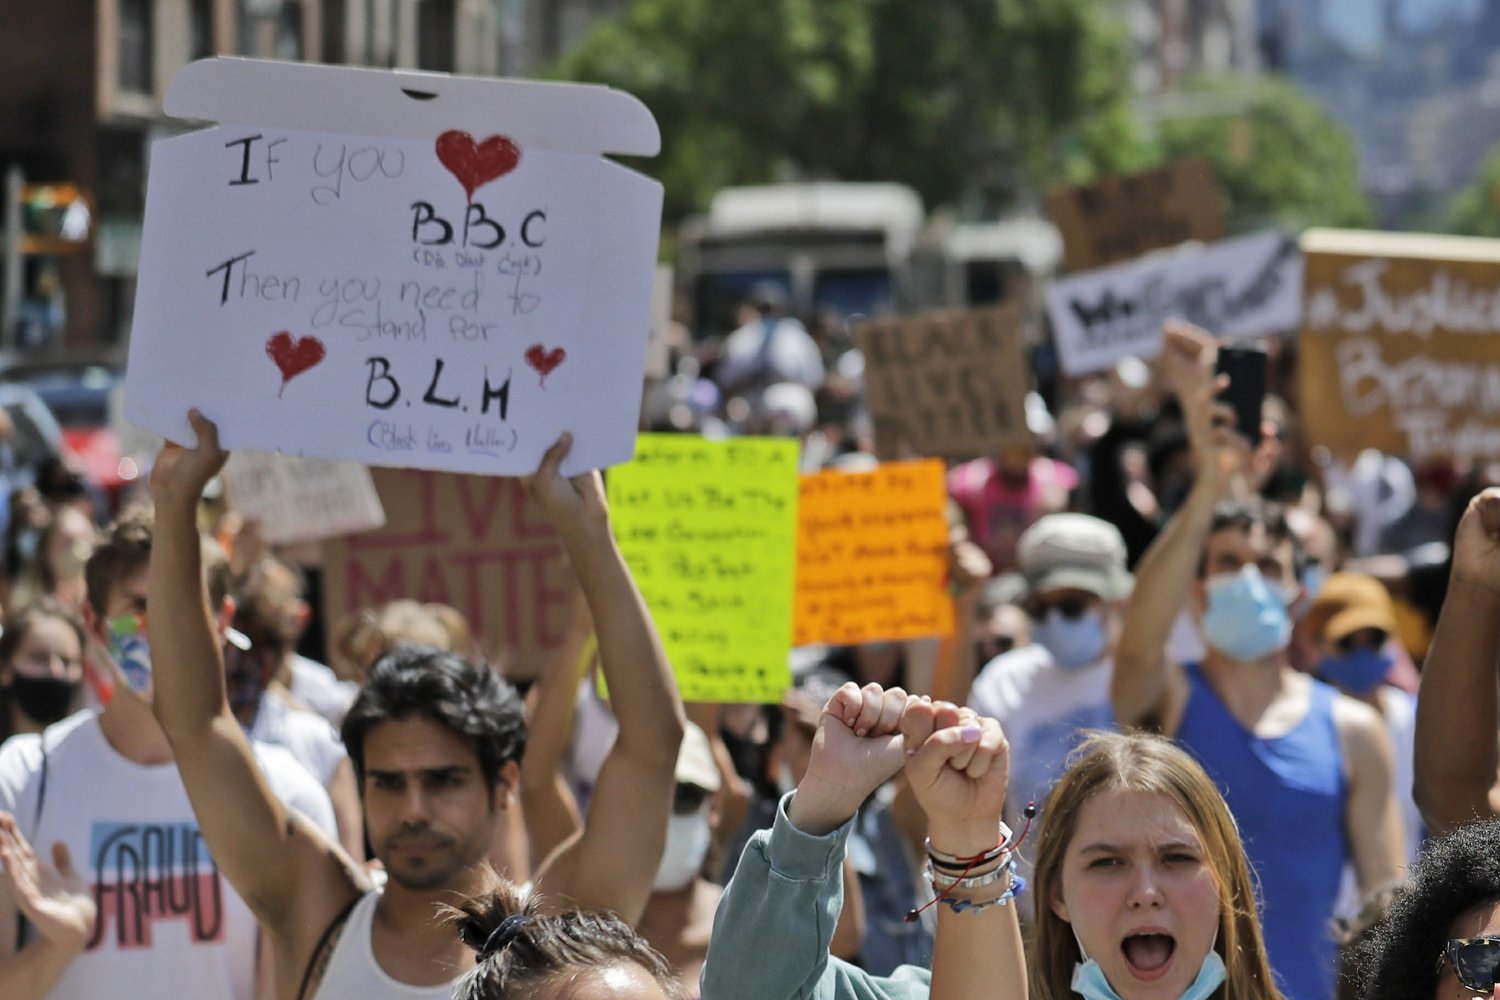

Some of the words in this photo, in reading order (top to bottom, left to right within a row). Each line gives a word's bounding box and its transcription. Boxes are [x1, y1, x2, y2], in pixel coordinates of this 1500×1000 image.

[311, 142, 406, 206] you
[206, 250, 301, 308] Then
[311, 276, 382, 330] you
[400, 268, 480, 313] need
[507, 264, 542, 316] to
[345, 546, 567, 649] MATTE
[86, 824, 223, 951] FRAUD
